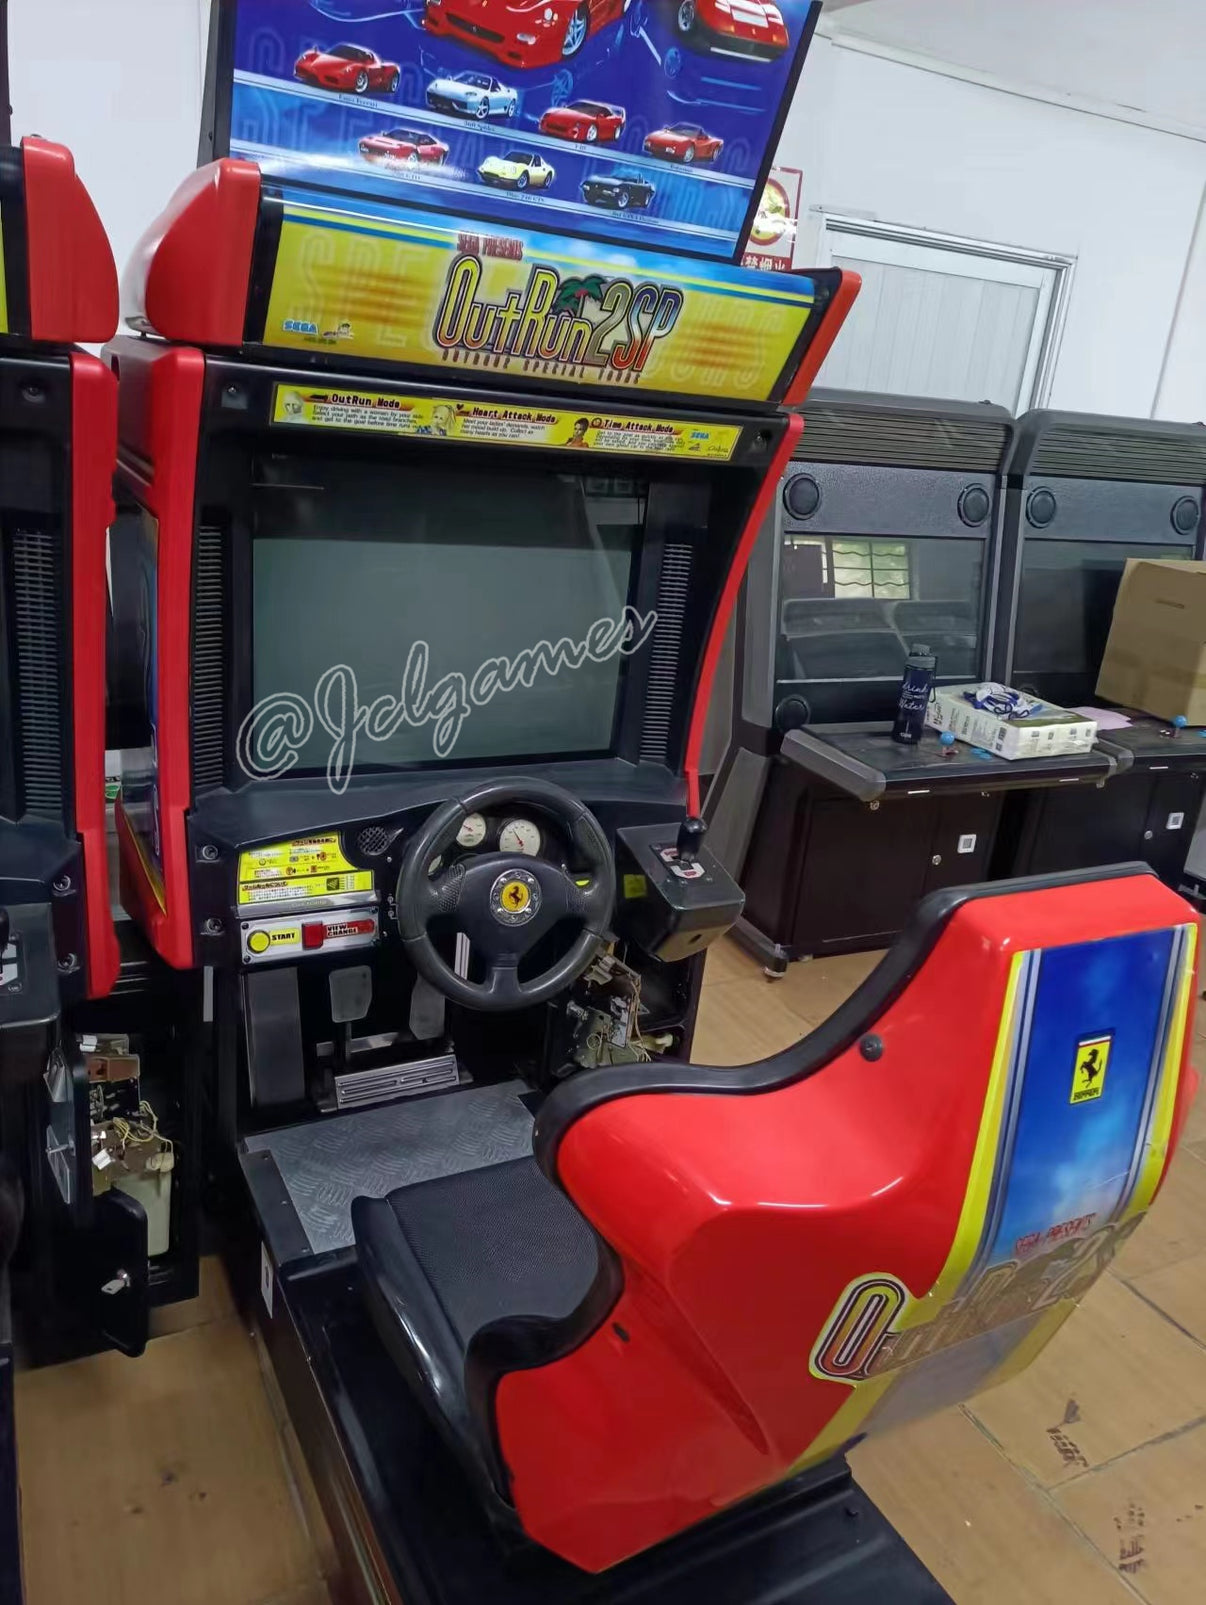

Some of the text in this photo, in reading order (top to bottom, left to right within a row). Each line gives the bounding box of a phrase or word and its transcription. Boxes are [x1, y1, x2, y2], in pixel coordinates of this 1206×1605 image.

[284, 319, 318, 336] SEGA
[332, 393, 400, 409] OutRun Mode
[473, 407, 556, 423] Heart Attack Mode
[604, 419, 674, 434] Time Attack Mode
[271, 932, 295, 941] START
